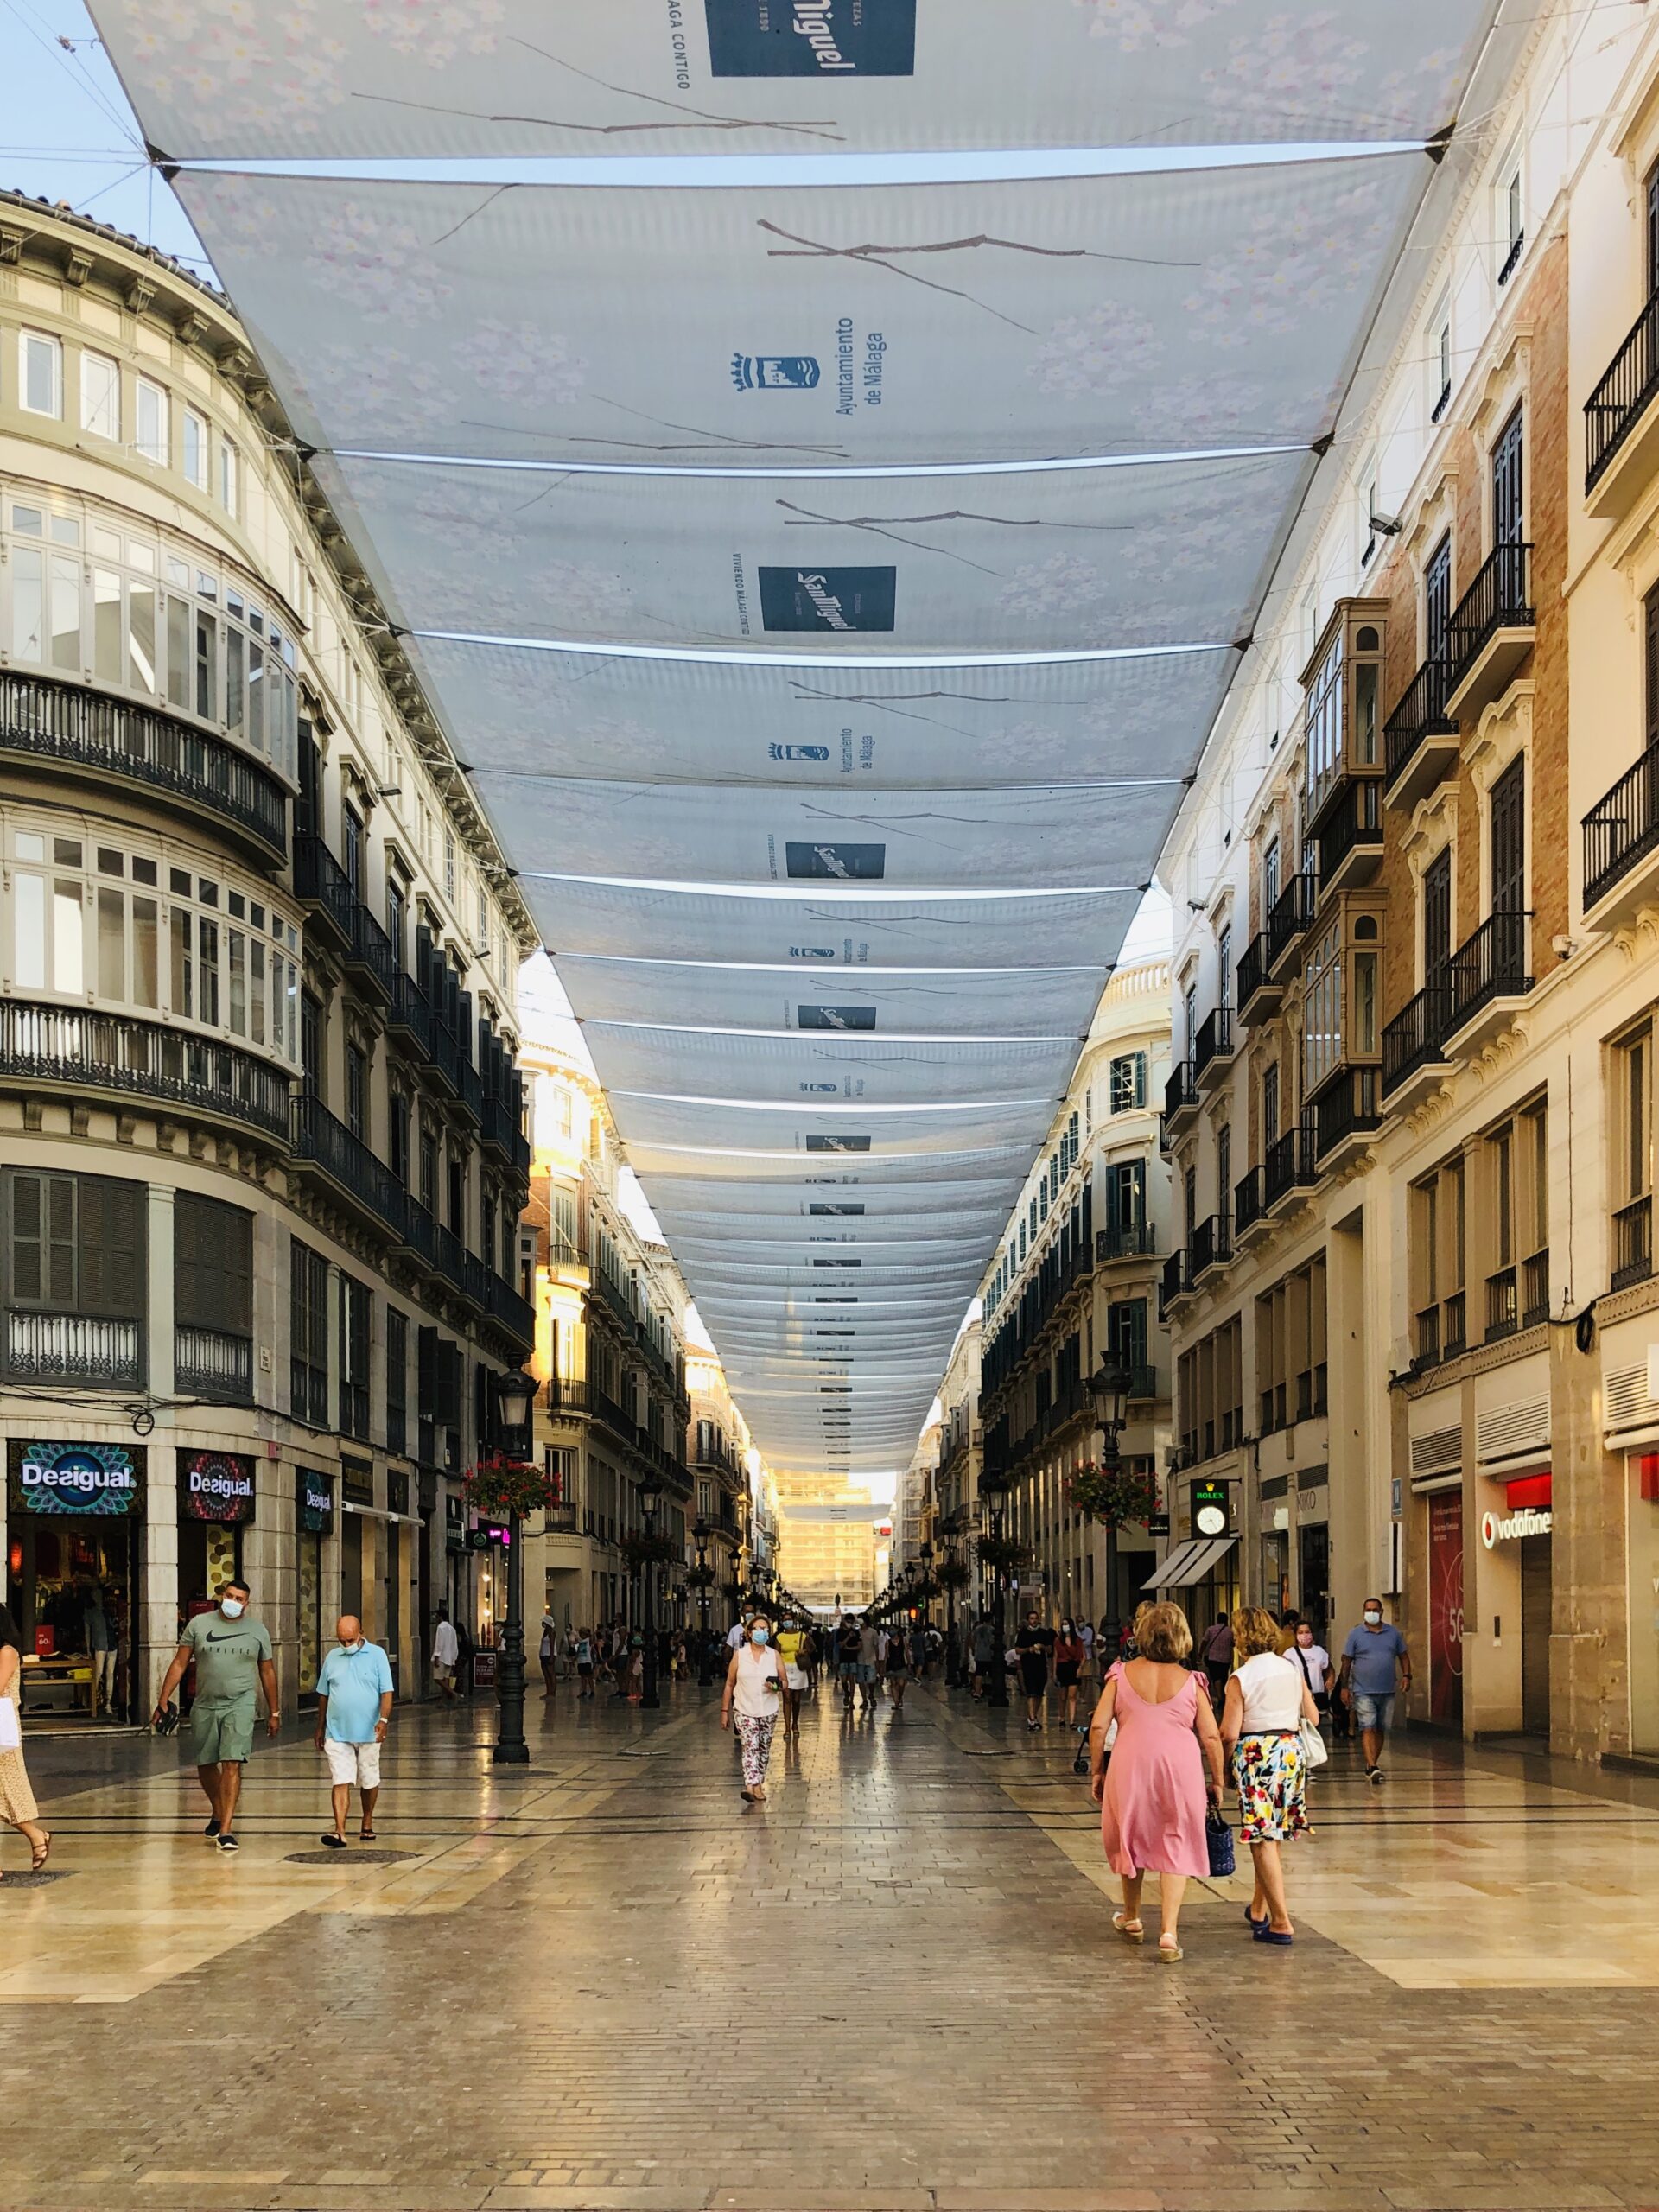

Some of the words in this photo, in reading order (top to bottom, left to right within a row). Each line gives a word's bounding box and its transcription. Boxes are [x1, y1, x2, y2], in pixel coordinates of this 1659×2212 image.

[672, 33, 690, 90] CONTIGO
[835, 317, 858, 416] Ayuntamiento
[862, 332, 887, 387] Málaga
[864, 390, 882, 405] de
[732, 553, 745, 588] VIVIENDO
[22, 1464, 130, 1492] Desigual
[190, 1471, 251, 1499] Desigual
[1497, 1508, 1553, 1540] vodafone
